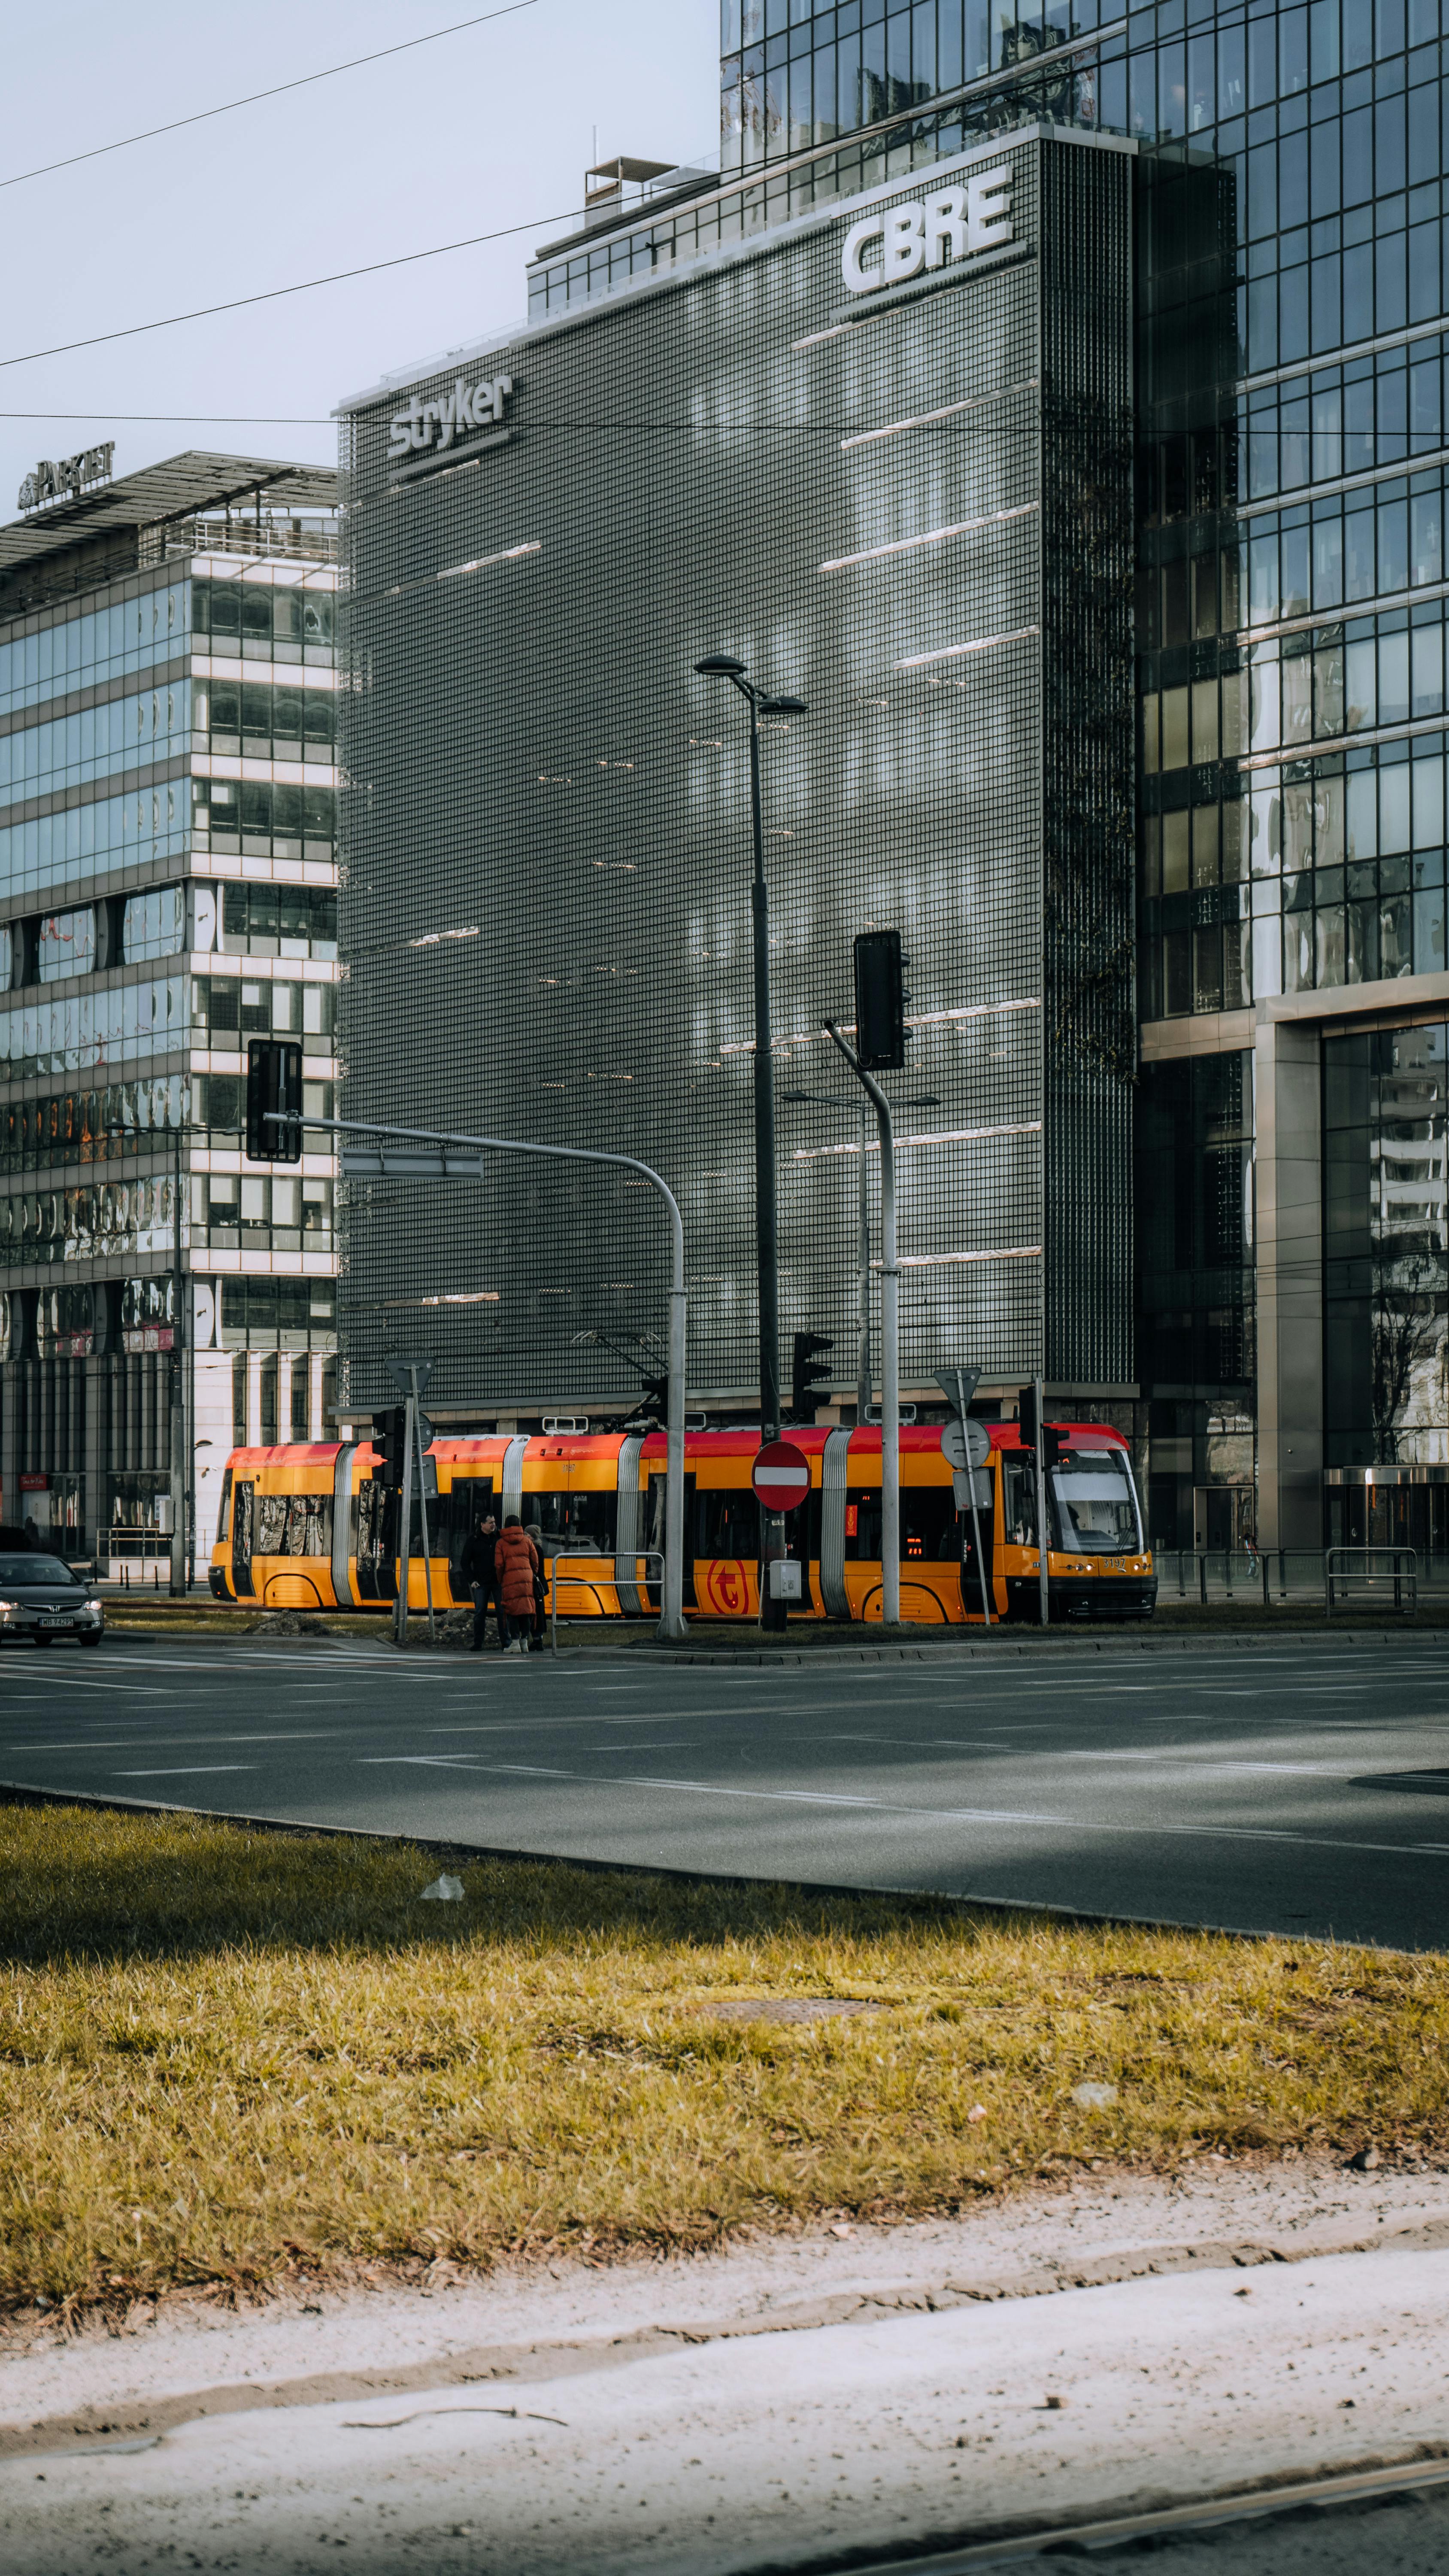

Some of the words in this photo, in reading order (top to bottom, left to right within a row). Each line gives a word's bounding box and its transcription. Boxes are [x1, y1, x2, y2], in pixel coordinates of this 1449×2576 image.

[841, 164, 1013, 293] CBRE
[388, 375, 512, 459] stryker
[1104, 1558, 1125, 1568] 3197
